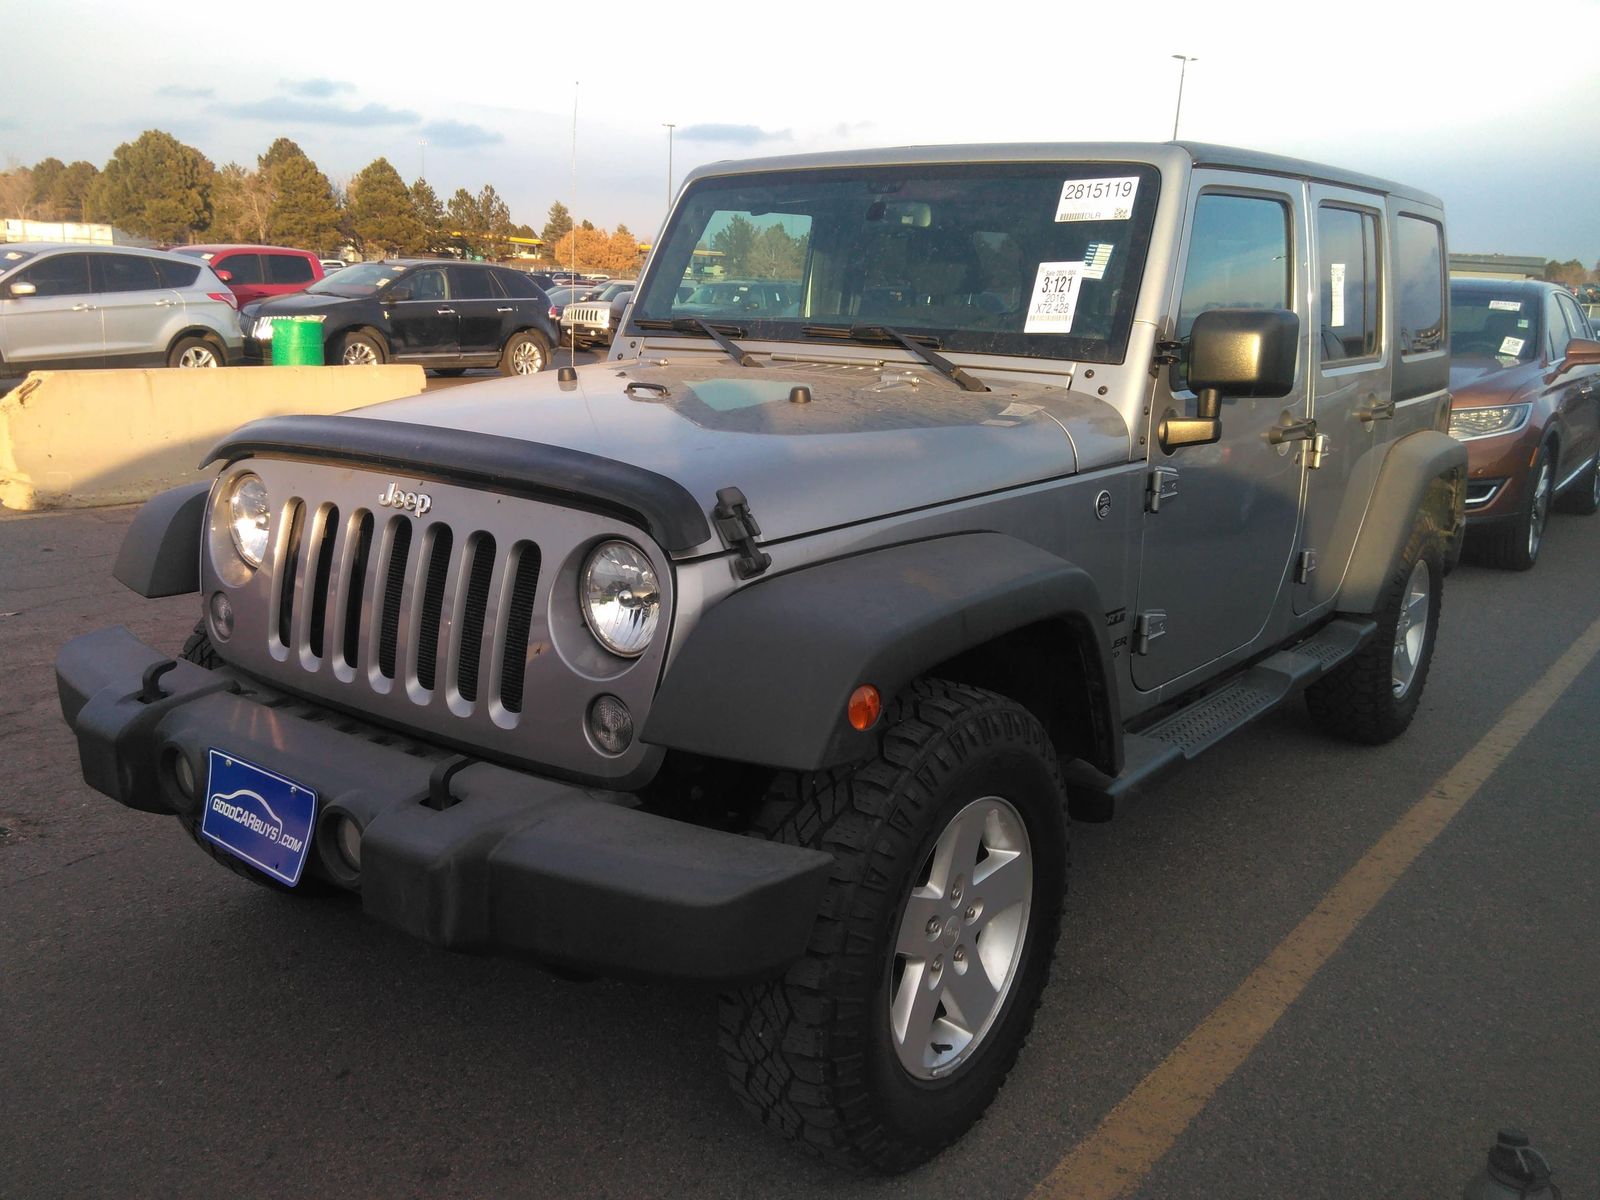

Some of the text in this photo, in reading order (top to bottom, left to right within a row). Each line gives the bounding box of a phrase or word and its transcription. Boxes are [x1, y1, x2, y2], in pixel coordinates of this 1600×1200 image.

[1065, 181, 1132, 199] 2815119
[1042, 276, 1073, 293] 3:121
[1045, 293, 1066, 302] 2016
[378, 481, 432, 518] Jeep
